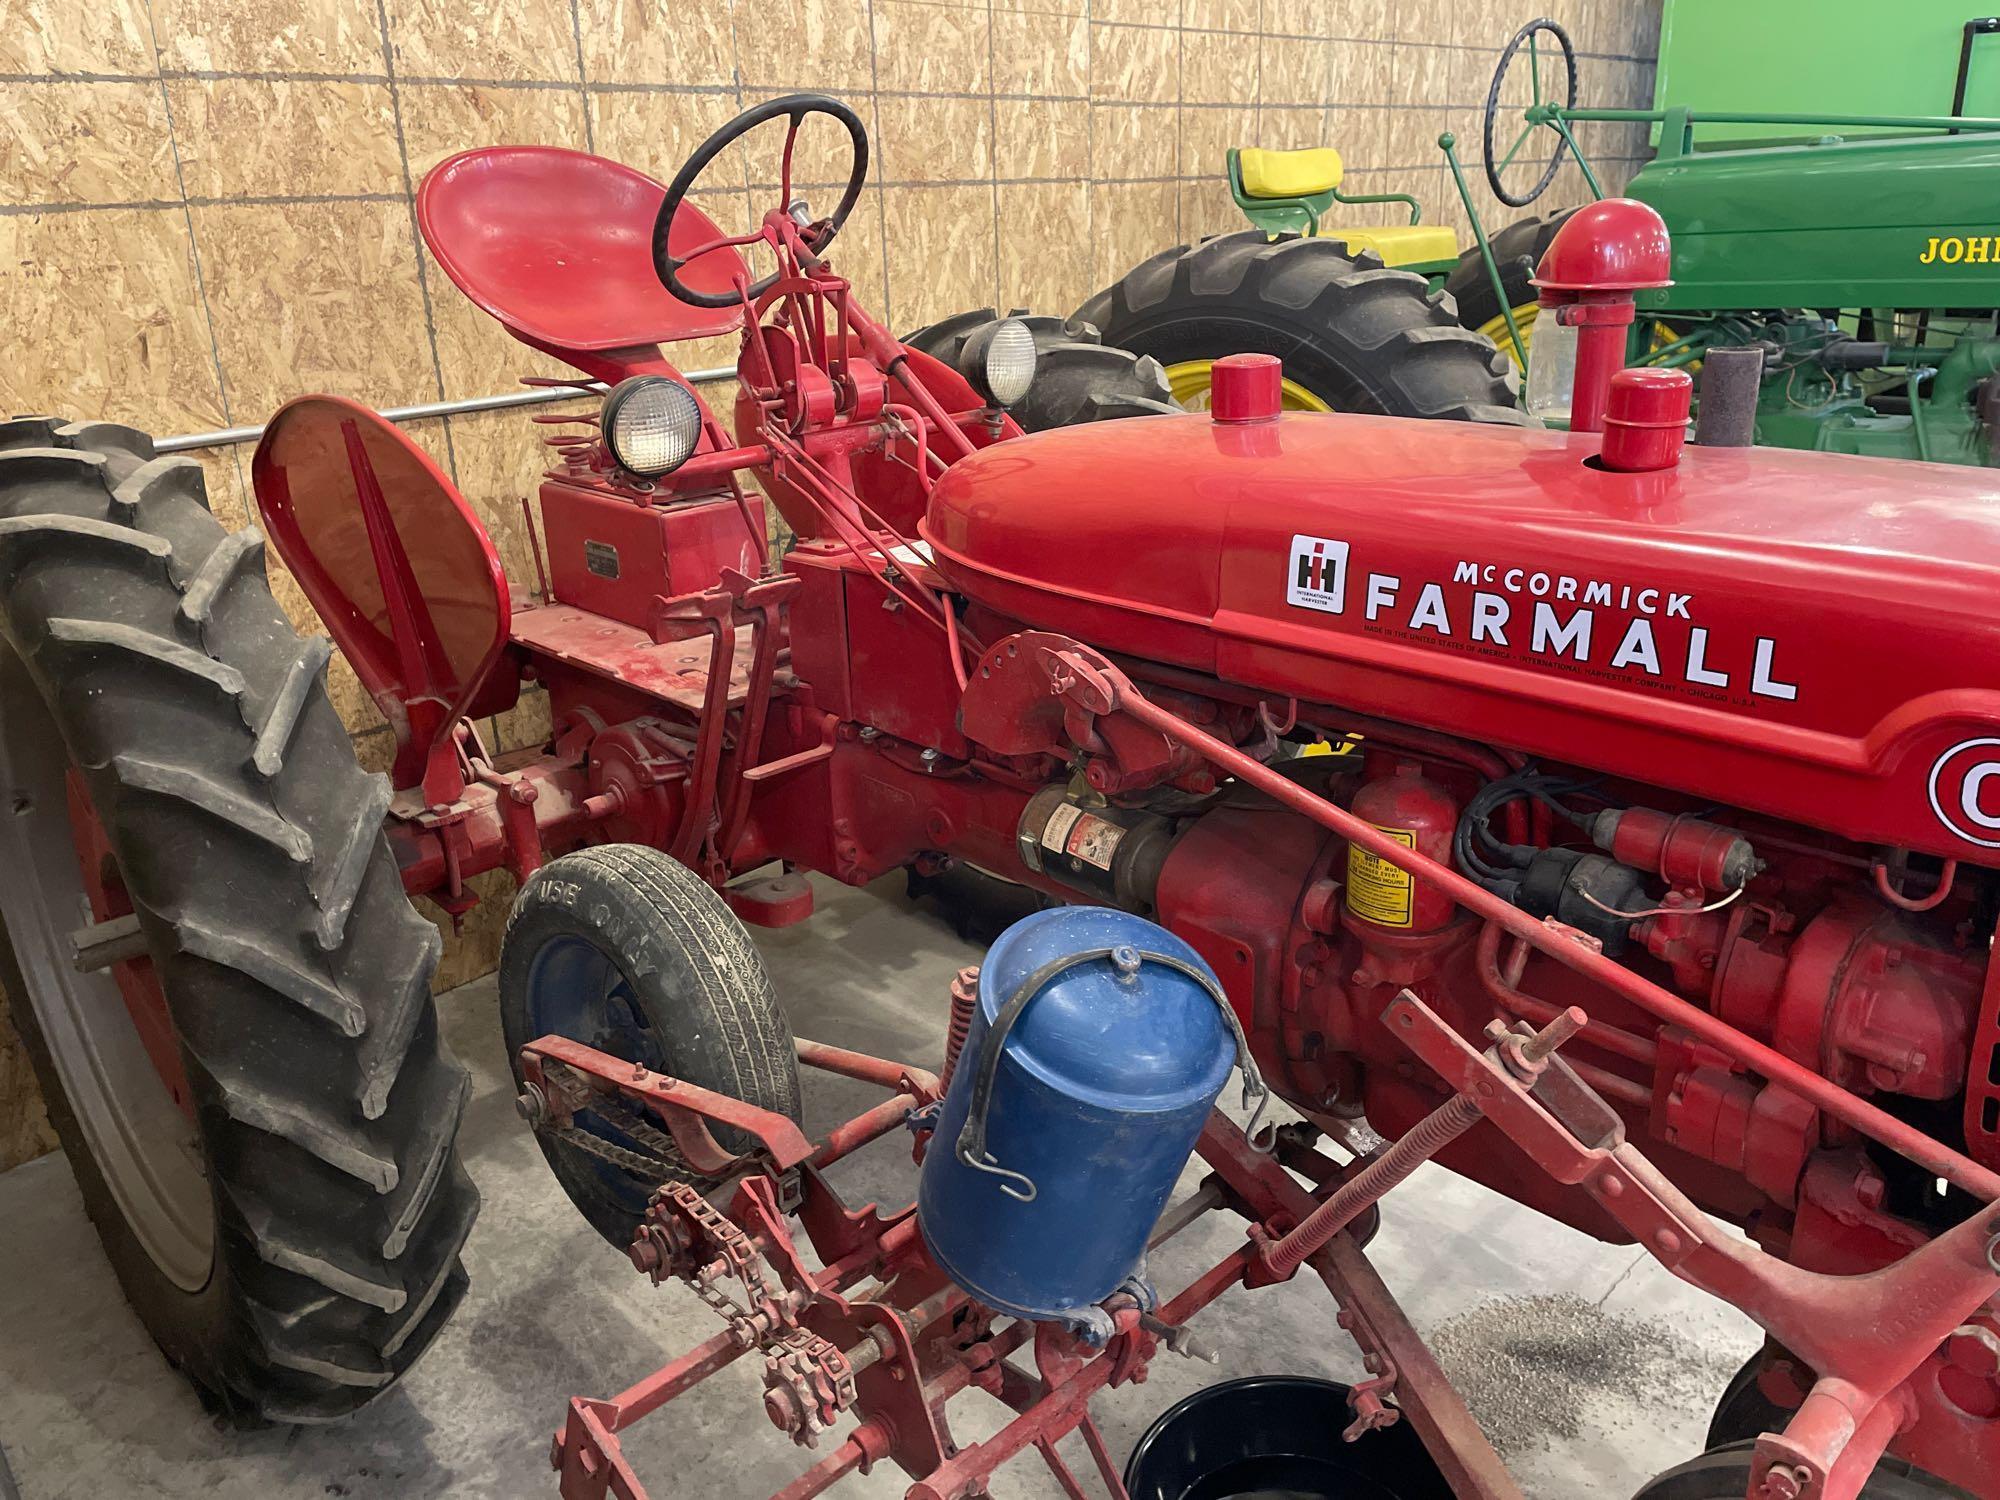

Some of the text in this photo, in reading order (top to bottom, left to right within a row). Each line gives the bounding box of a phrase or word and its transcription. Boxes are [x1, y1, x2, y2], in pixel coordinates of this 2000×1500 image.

[1297, 590, 1334, 601] INTERNATIONAL
[1301, 597, 1328, 606] HARVESTER
[1365, 573, 1798, 700] FARMALL
[1364, 625, 1381, 635] MADE
[1384, 628, 1392, 636] IN
[1394, 630, 1407, 639] THE
[1410, 633, 1436, 645] UNITED
[1438, 639, 1464, 650] STATES
[1478, 647, 1511, 660] AMERICA
[1520, 655, 1581, 674] INTERNATIONAL
[1585, 667, 1633, 684] HARVESTER
[1635, 678, 1677, 693] COMPANY
